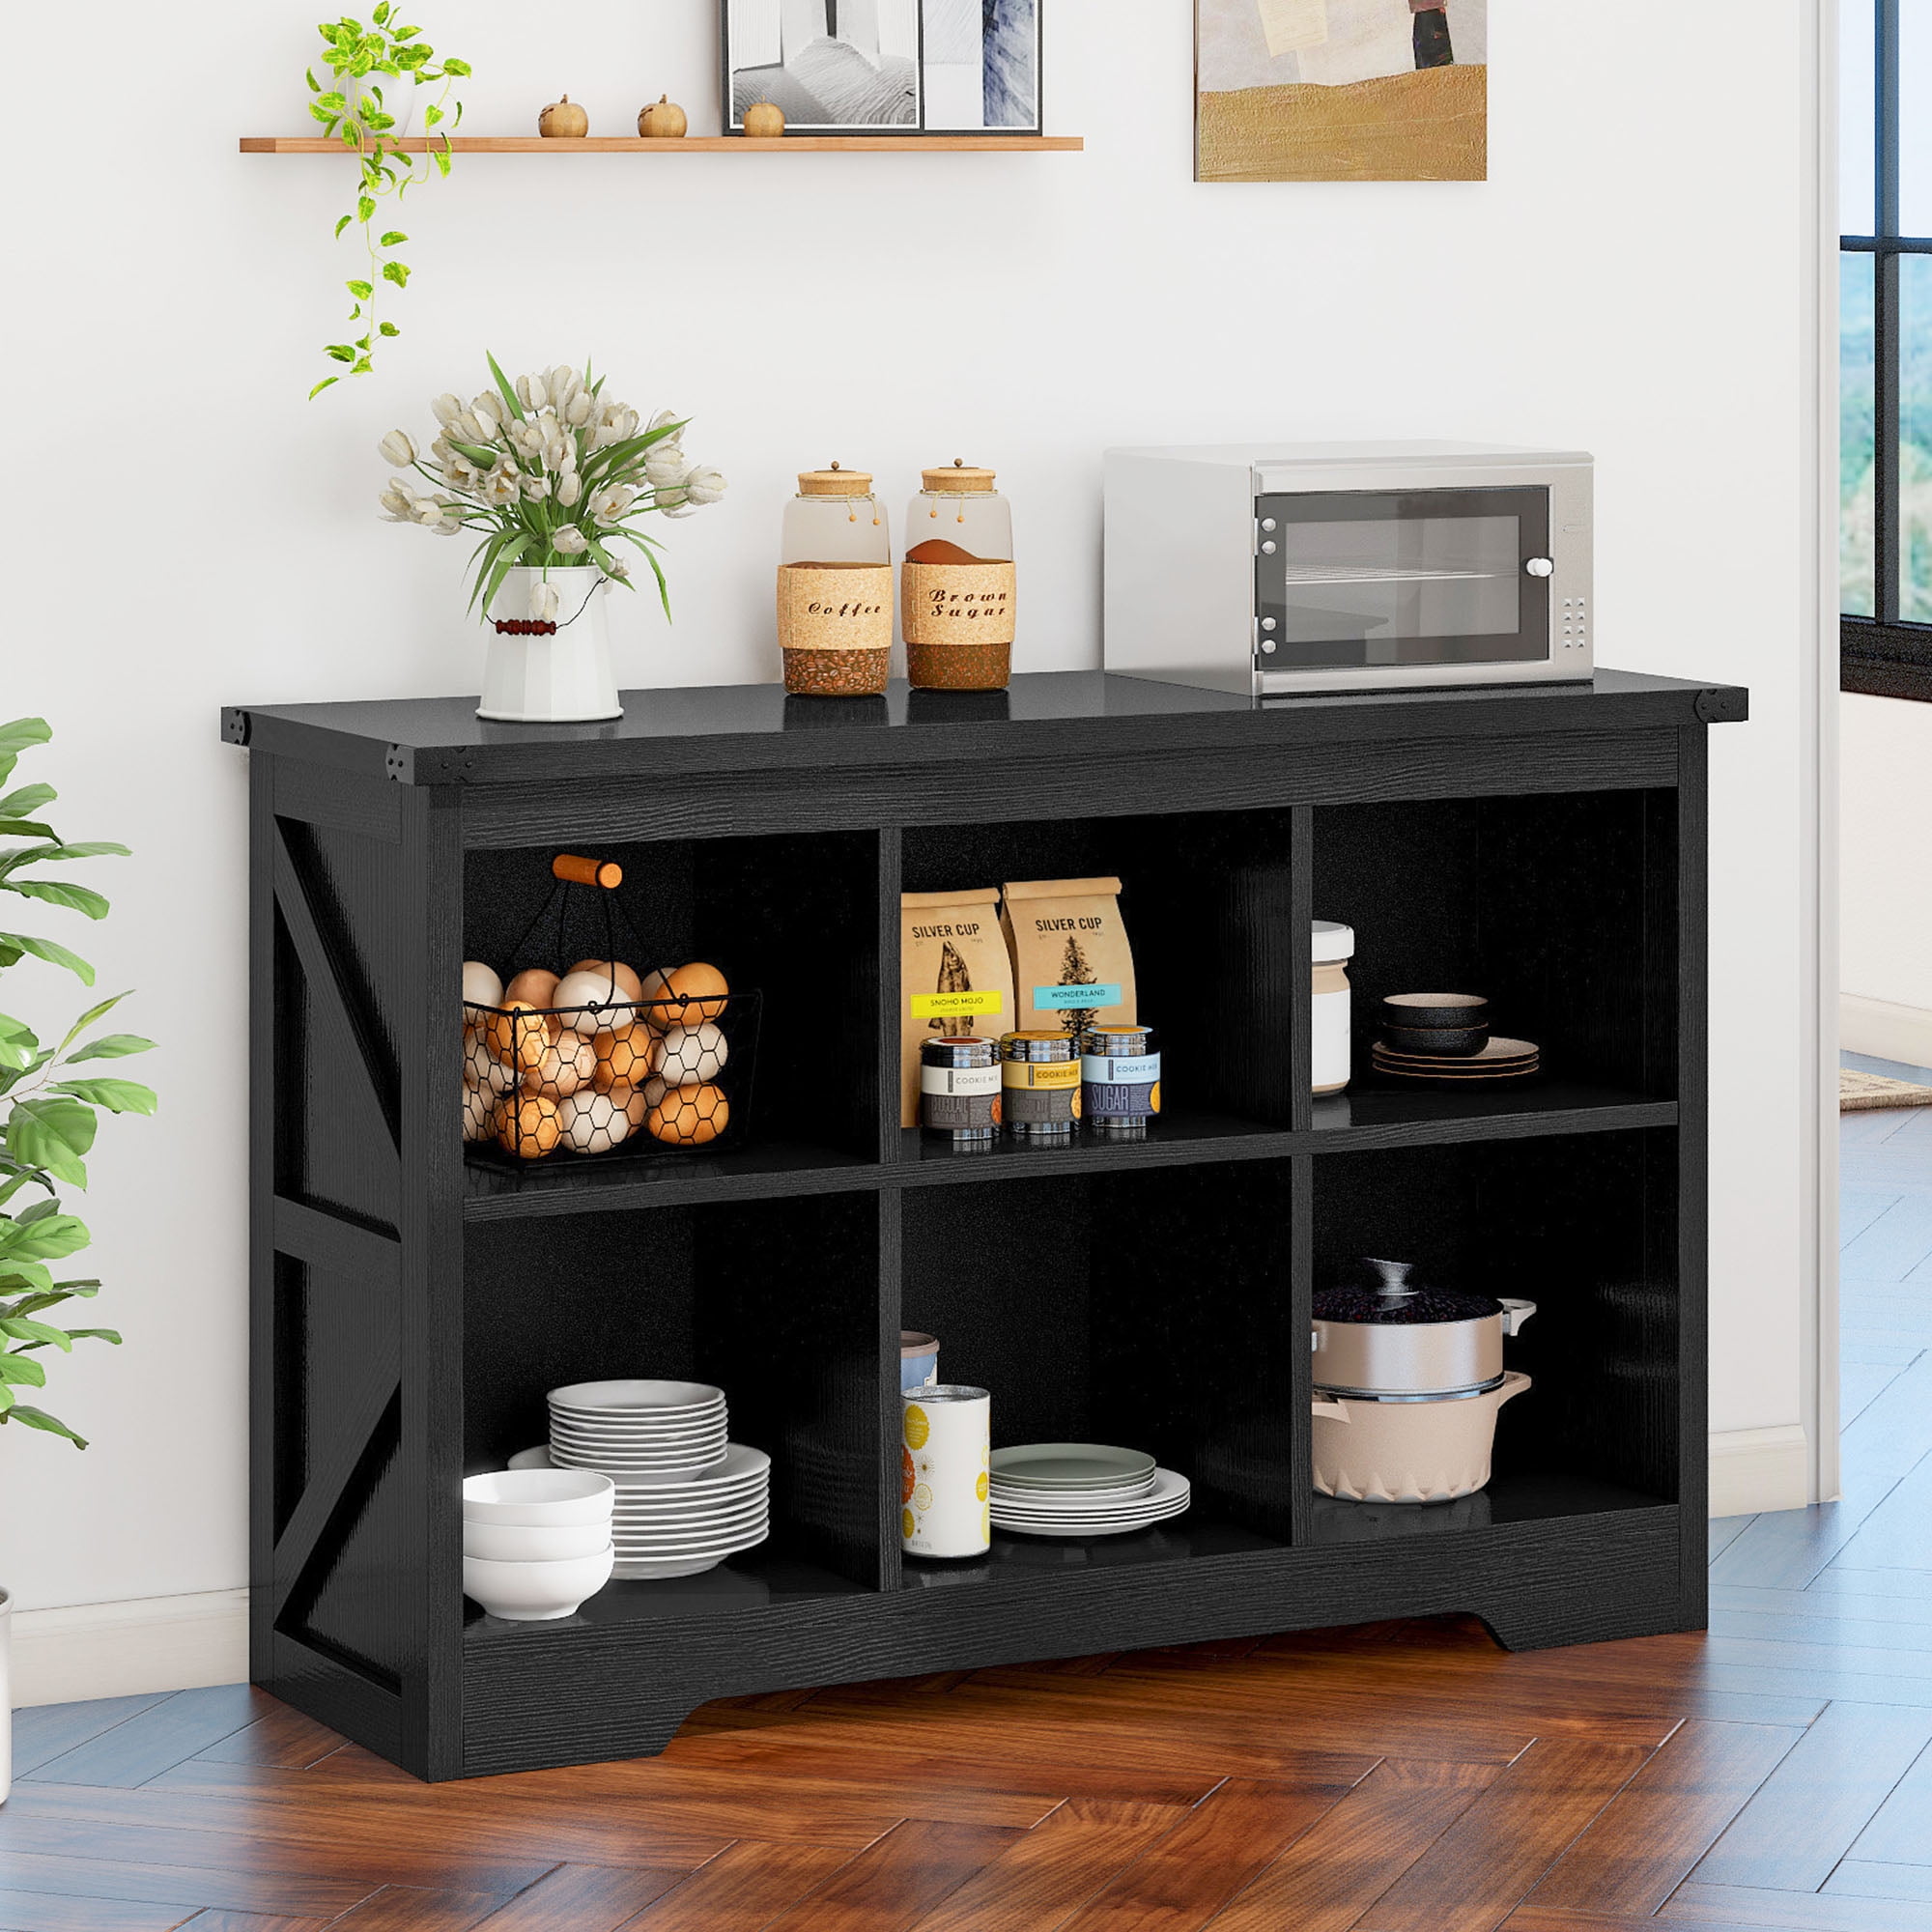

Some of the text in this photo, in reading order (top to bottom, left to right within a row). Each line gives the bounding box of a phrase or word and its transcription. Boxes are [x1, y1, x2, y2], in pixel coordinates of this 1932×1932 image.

[928, 588, 1007, 603] Brown
[808, 602, 881, 617] Coffee
[930, 604, 1007, 619] Sugar
[912, 923, 980, 939] SILVER CUP
[1035, 917, 1102, 932] SILVER CUP
[1051, 989, 1106, 998] WONDERLAND
[960, 997, 983, 1006] MOJO
[1036, 1069, 1067, 1079] COOKIE
[1116, 1065, 1147, 1073] COOKIE
[955, 1076, 986, 1085] COOKIE
[1091, 1084, 1129, 1111] SUGAR
